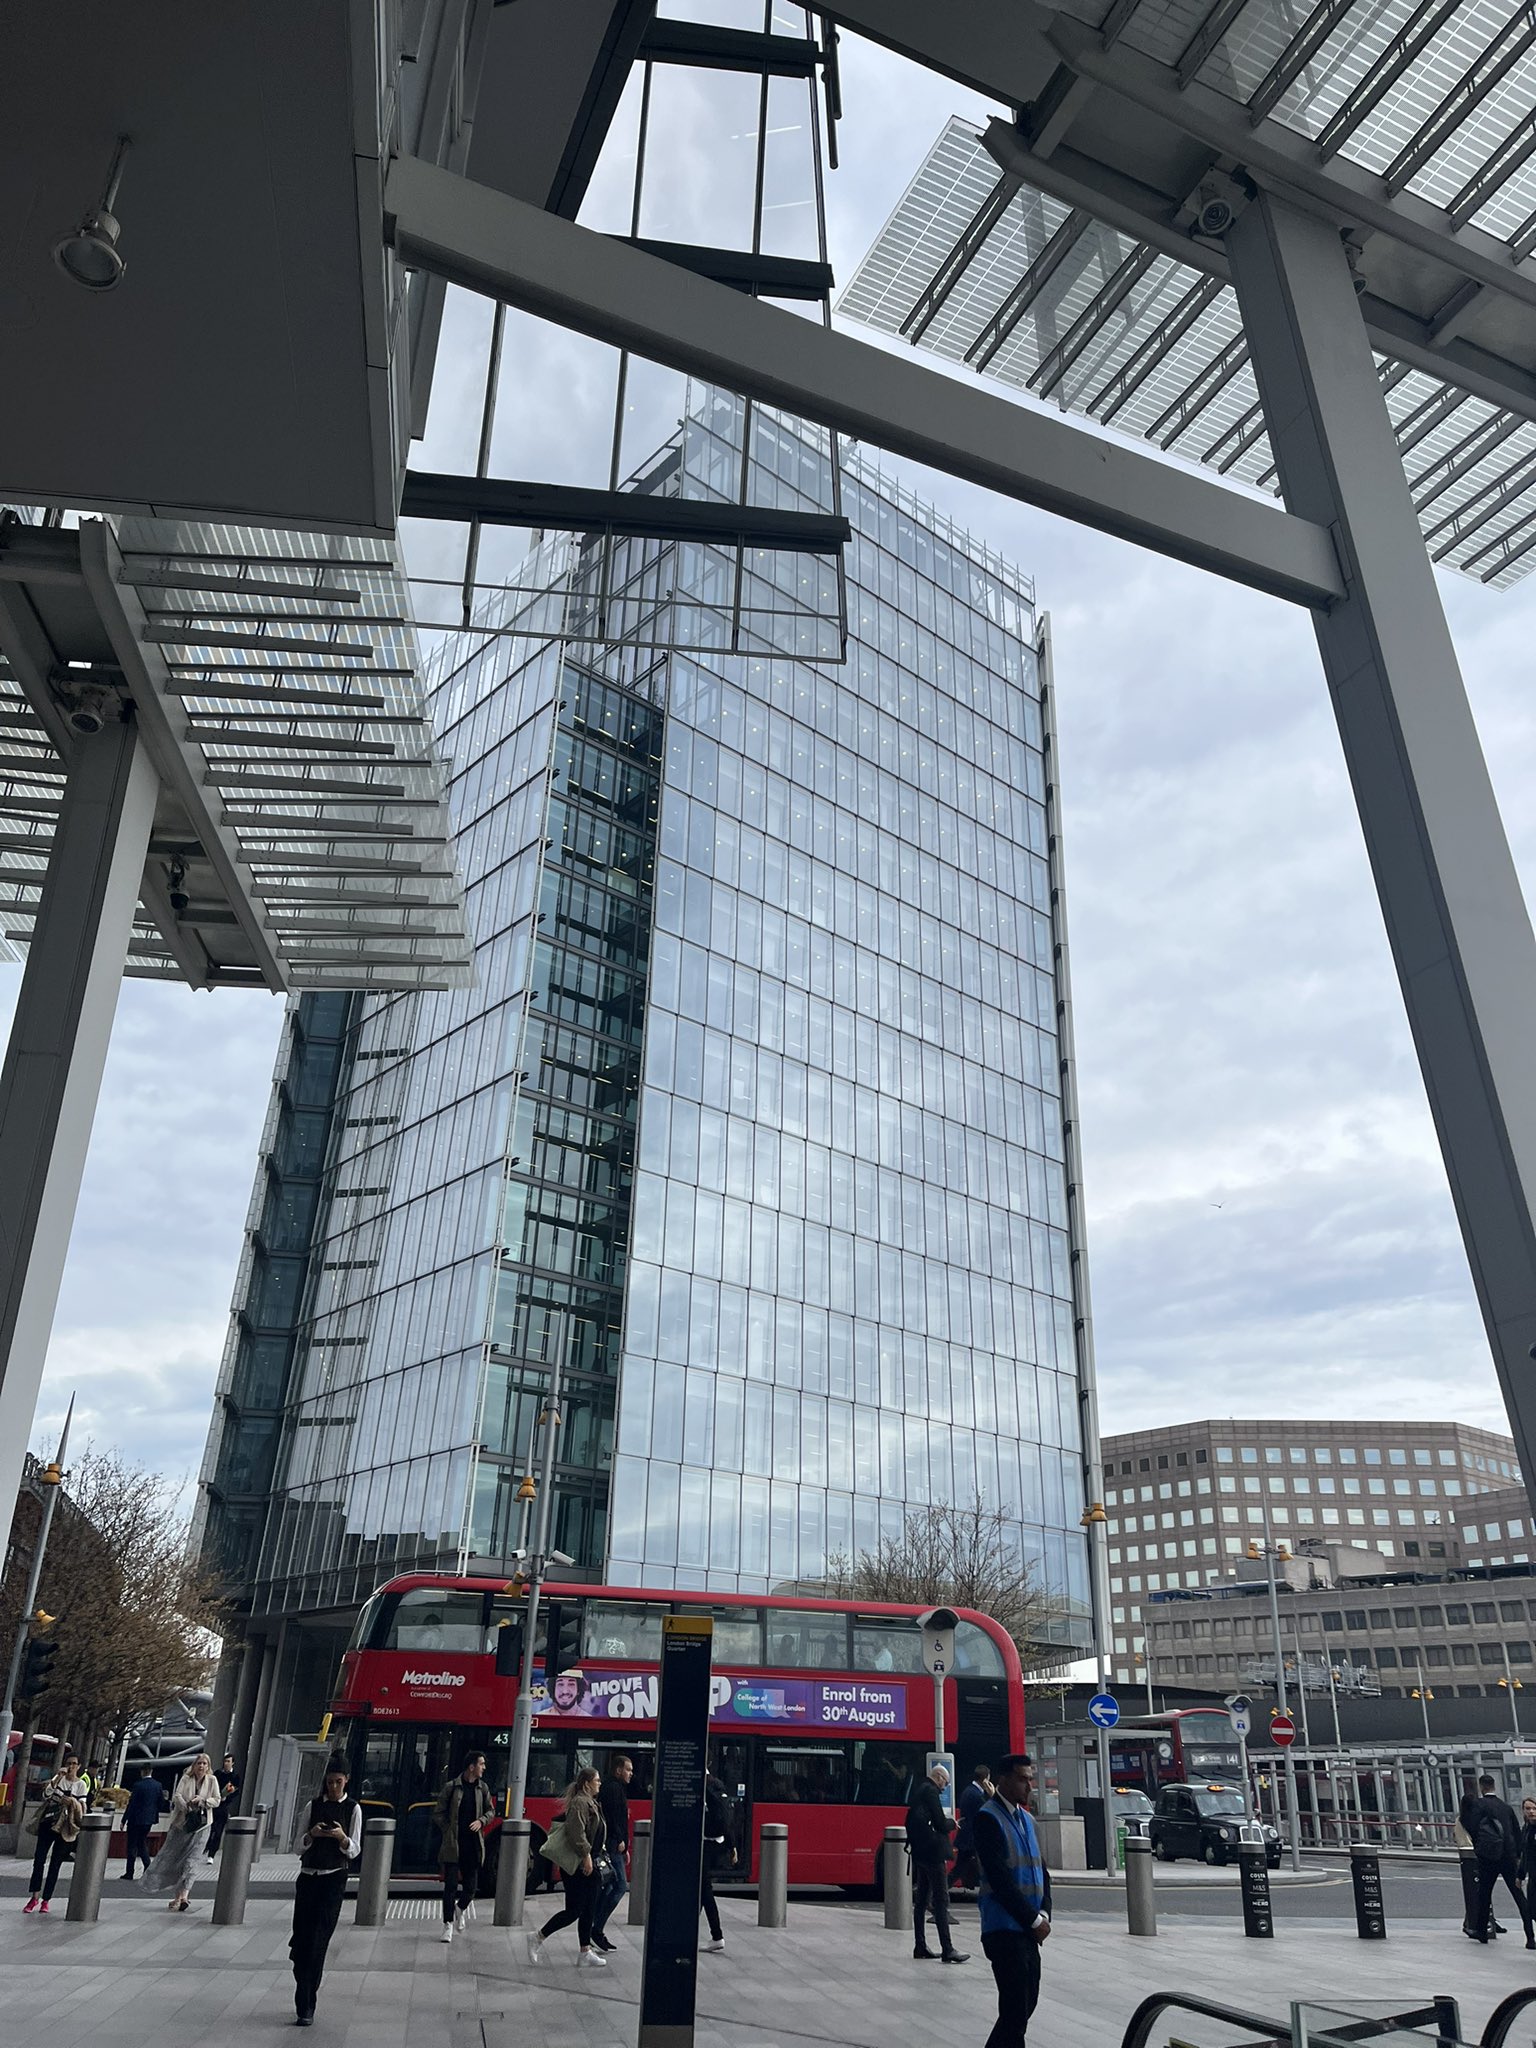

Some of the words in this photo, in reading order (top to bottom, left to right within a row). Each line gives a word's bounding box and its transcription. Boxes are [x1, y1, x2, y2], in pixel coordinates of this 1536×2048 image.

[401, 1670, 466, 1686] Metroline
[591, 1676, 643, 1697] MOVE
[737, 1694, 759, 1702] College
[822, 1686, 857, 1702] Enrol
[859, 1687, 892, 1704] from
[607, 1691, 659, 1719] ON
[748, 1703, 767, 1711] North
[847, 1709, 896, 1727] August
[493, 1733, 509, 1744] 43
[530, 1736, 552, 1744] Barnet
